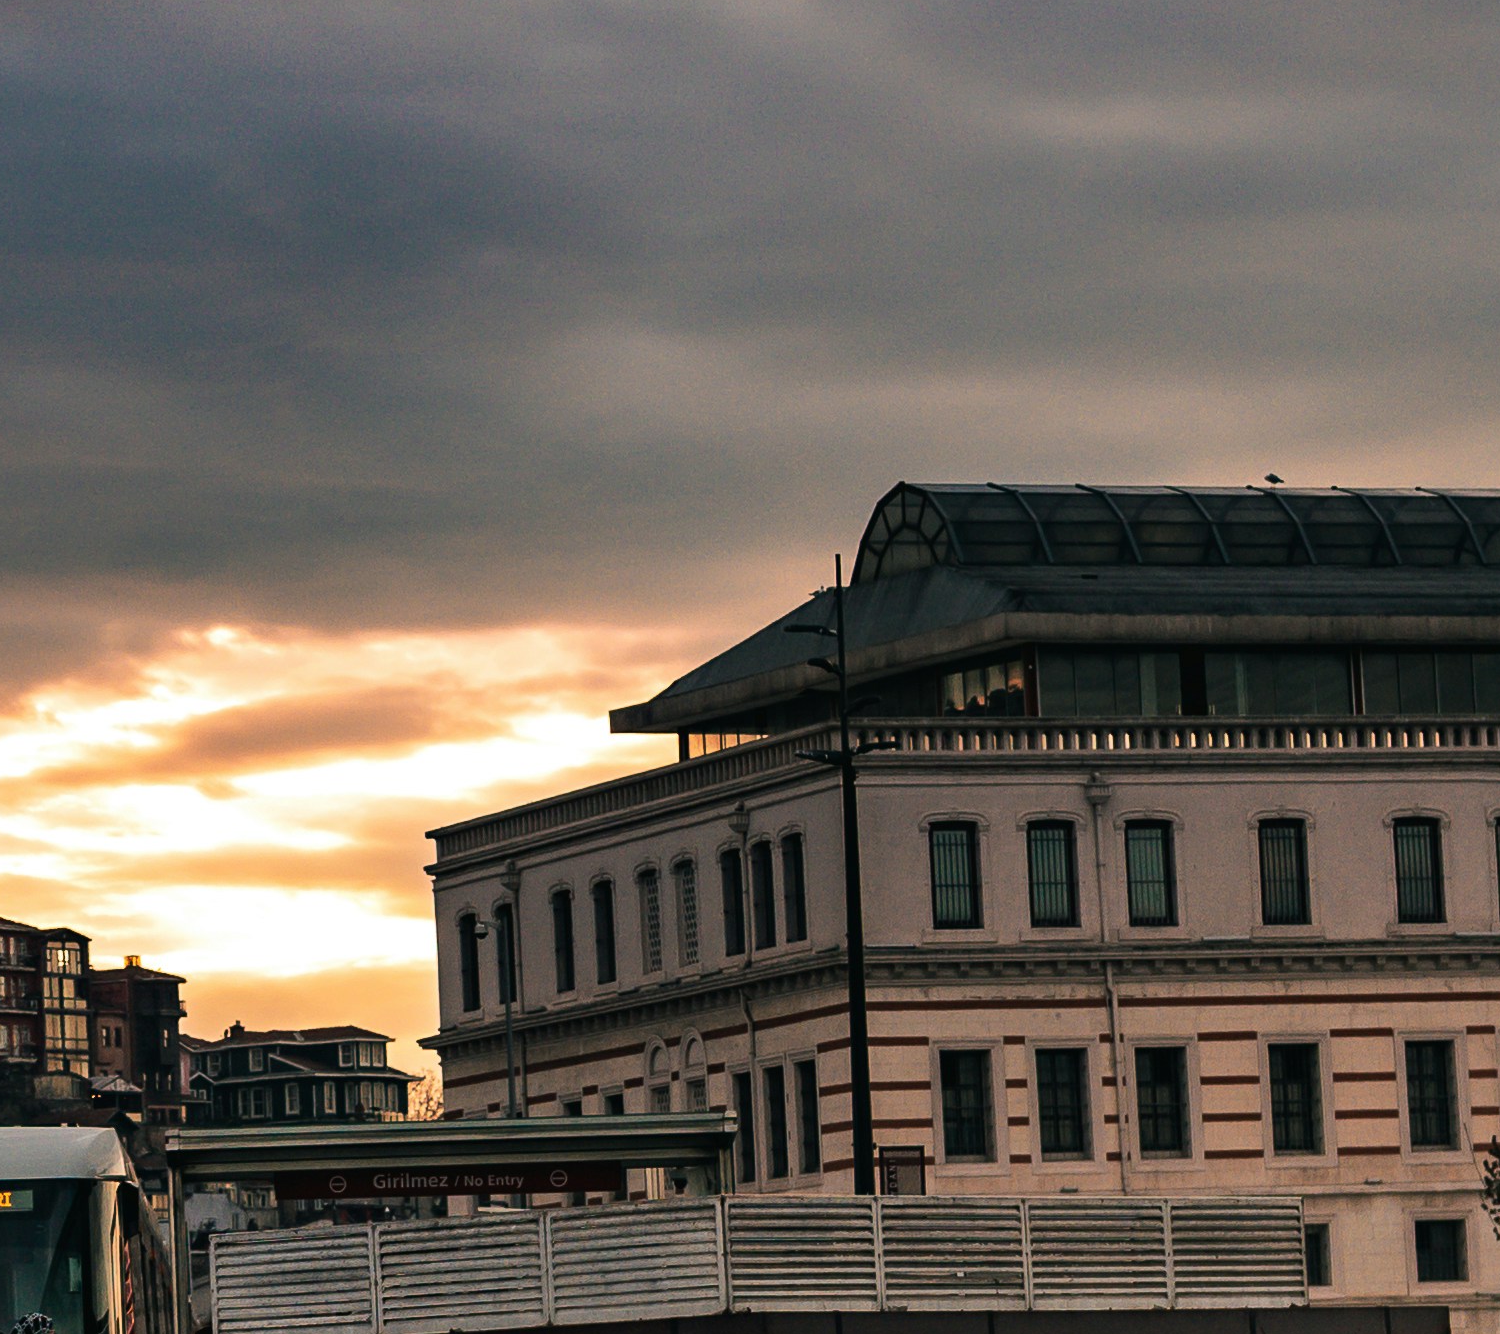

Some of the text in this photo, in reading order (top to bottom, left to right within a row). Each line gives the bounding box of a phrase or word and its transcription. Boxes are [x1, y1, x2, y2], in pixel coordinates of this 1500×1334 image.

[373, 1172, 449, 1190] Girilmez
[464, 1174, 484, 1187] No
[487, 1173, 524, 1189] Entry
